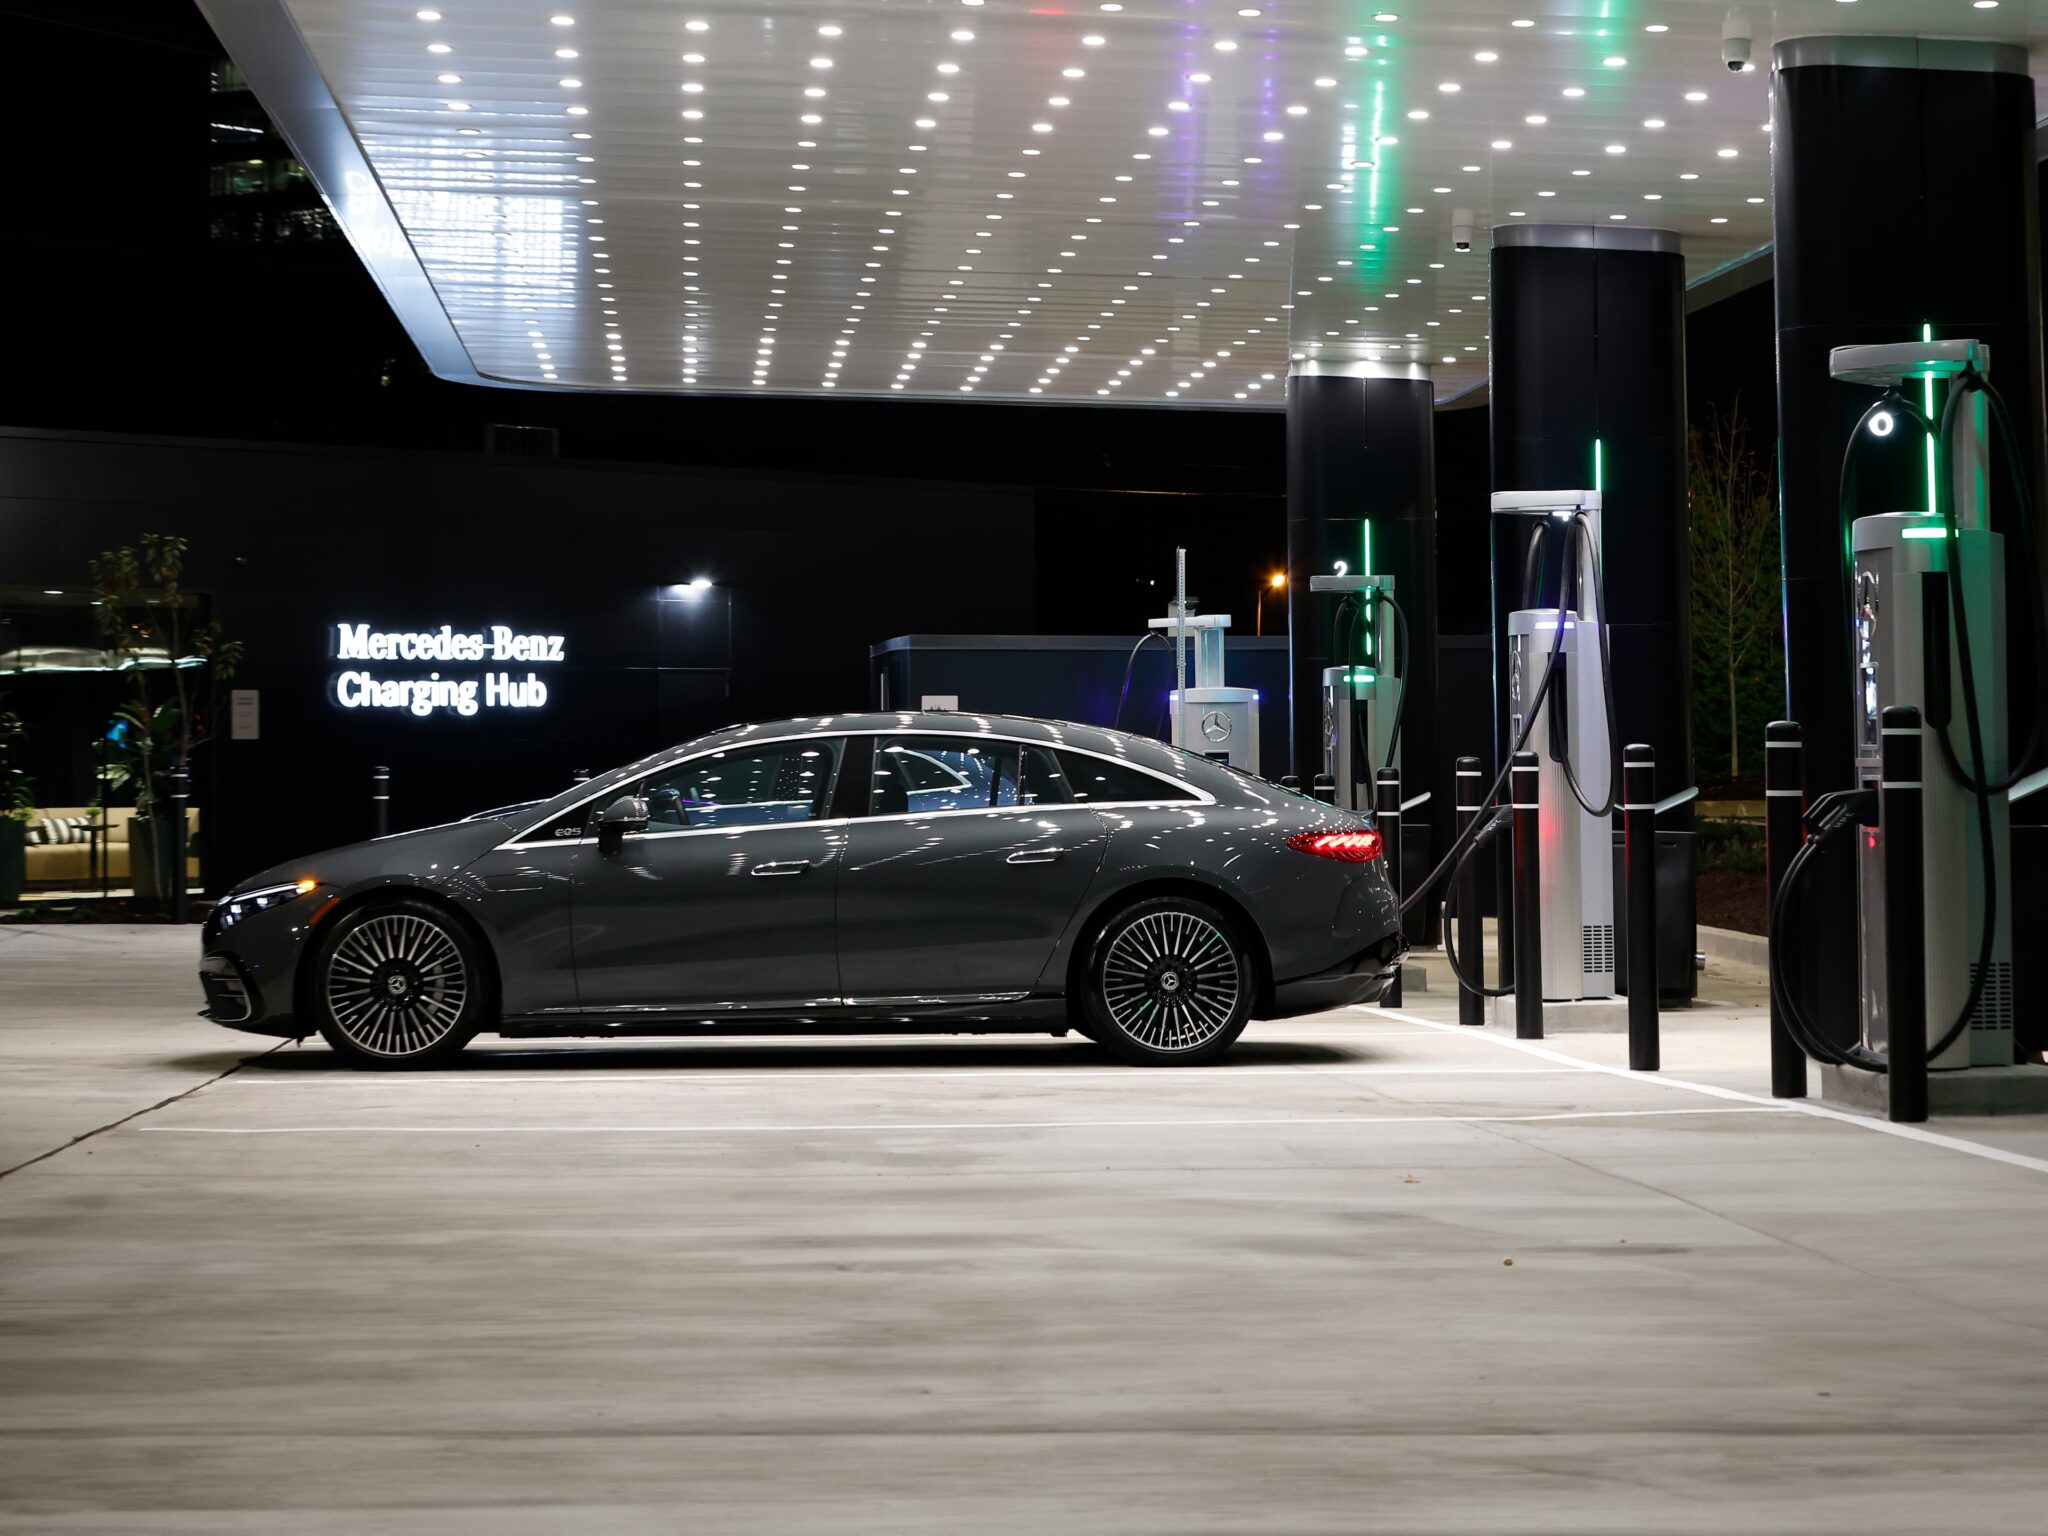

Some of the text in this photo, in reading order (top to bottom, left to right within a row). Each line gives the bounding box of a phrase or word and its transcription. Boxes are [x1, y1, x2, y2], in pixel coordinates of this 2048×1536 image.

[1333, 560, 1348, 577] 2
[337, 623, 565, 661] Mercedes-Benz
[337, 671, 548, 717] Charging Hub
